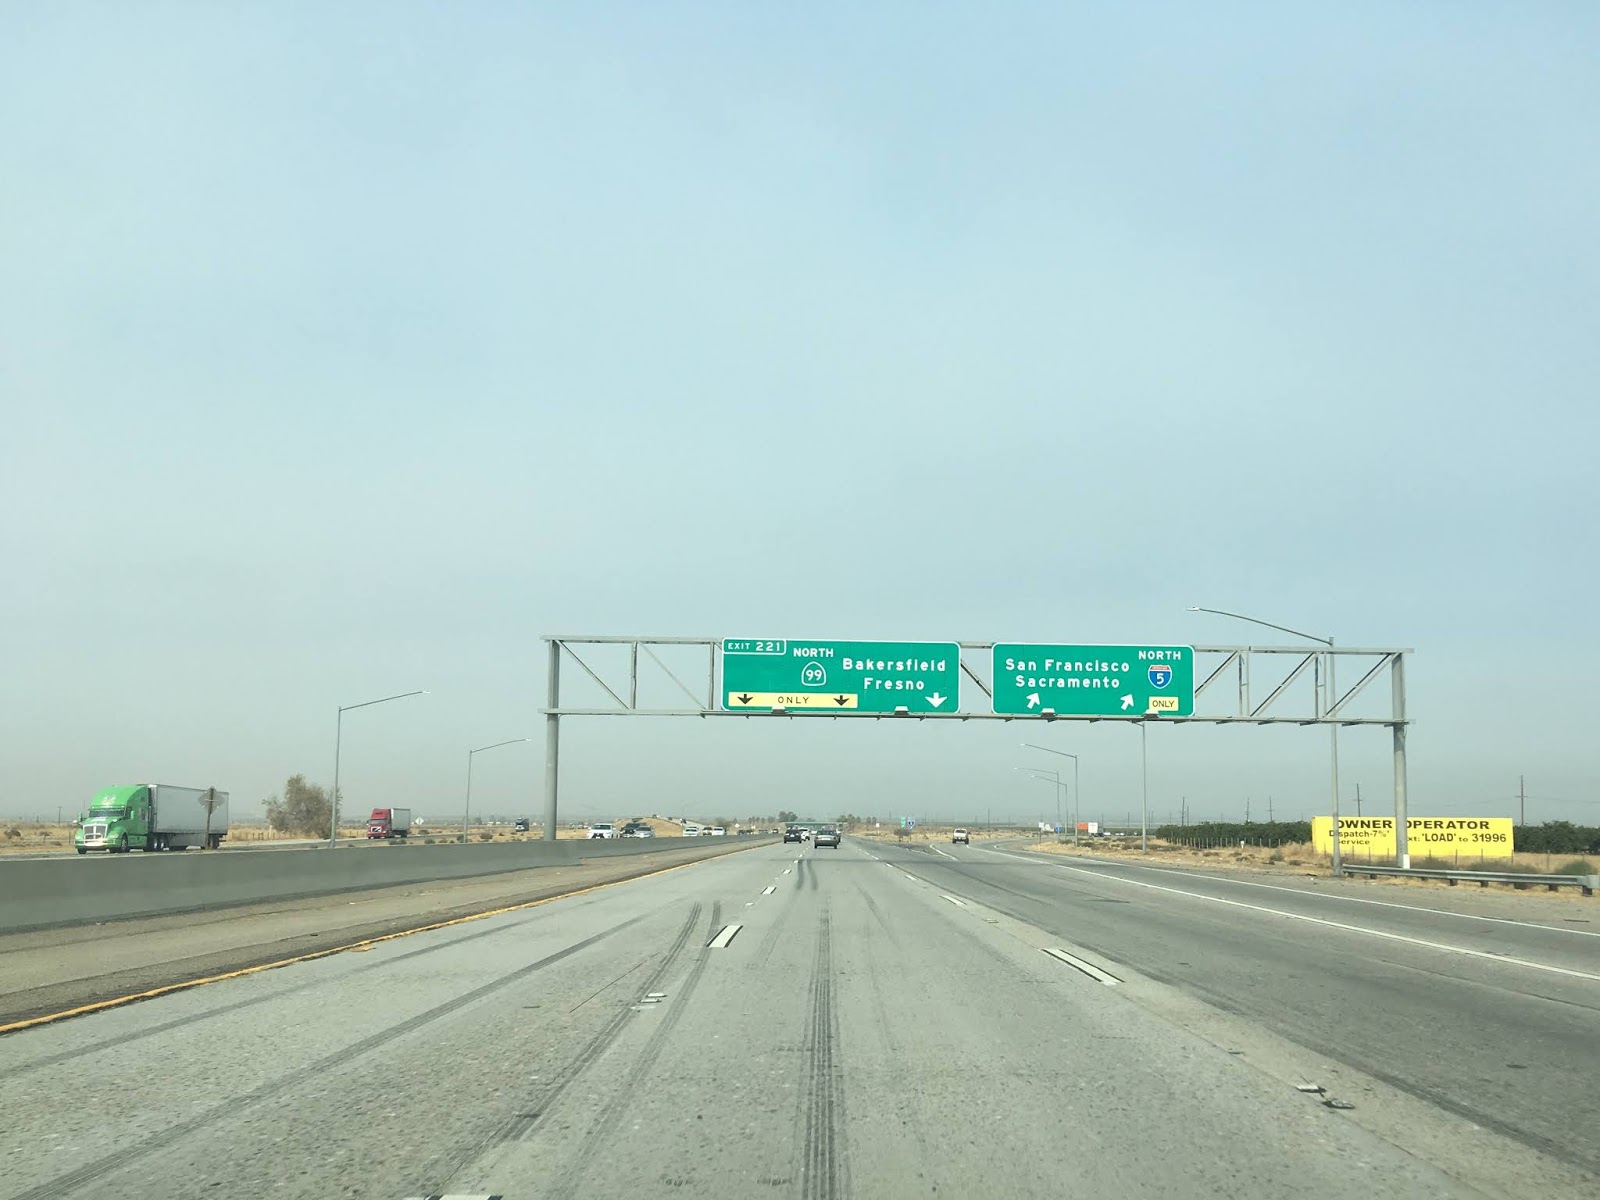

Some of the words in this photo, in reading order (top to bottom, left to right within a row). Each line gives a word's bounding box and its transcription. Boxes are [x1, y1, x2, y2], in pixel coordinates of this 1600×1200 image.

[728, 642, 750, 651] EXIT
[755, 642, 781, 652] 221
[793, 647, 834, 658] NORTH
[1138, 650, 1181, 661] NORTH
[842, 658, 946, 672] Bakersfield
[1005, 658, 1037, 671] San
[1044, 659, 1130, 673] Francisco
[805, 669, 823, 681] 99
[1156, 672, 1165, 685] 5
[863, 677, 925, 691] Fresno
[1015, 675, 1120, 689] Sacramento
[777, 696, 810, 705] ONLY
[1152, 700, 1175, 708] ONLY
[1471, 833, 1507, 843] 31996
